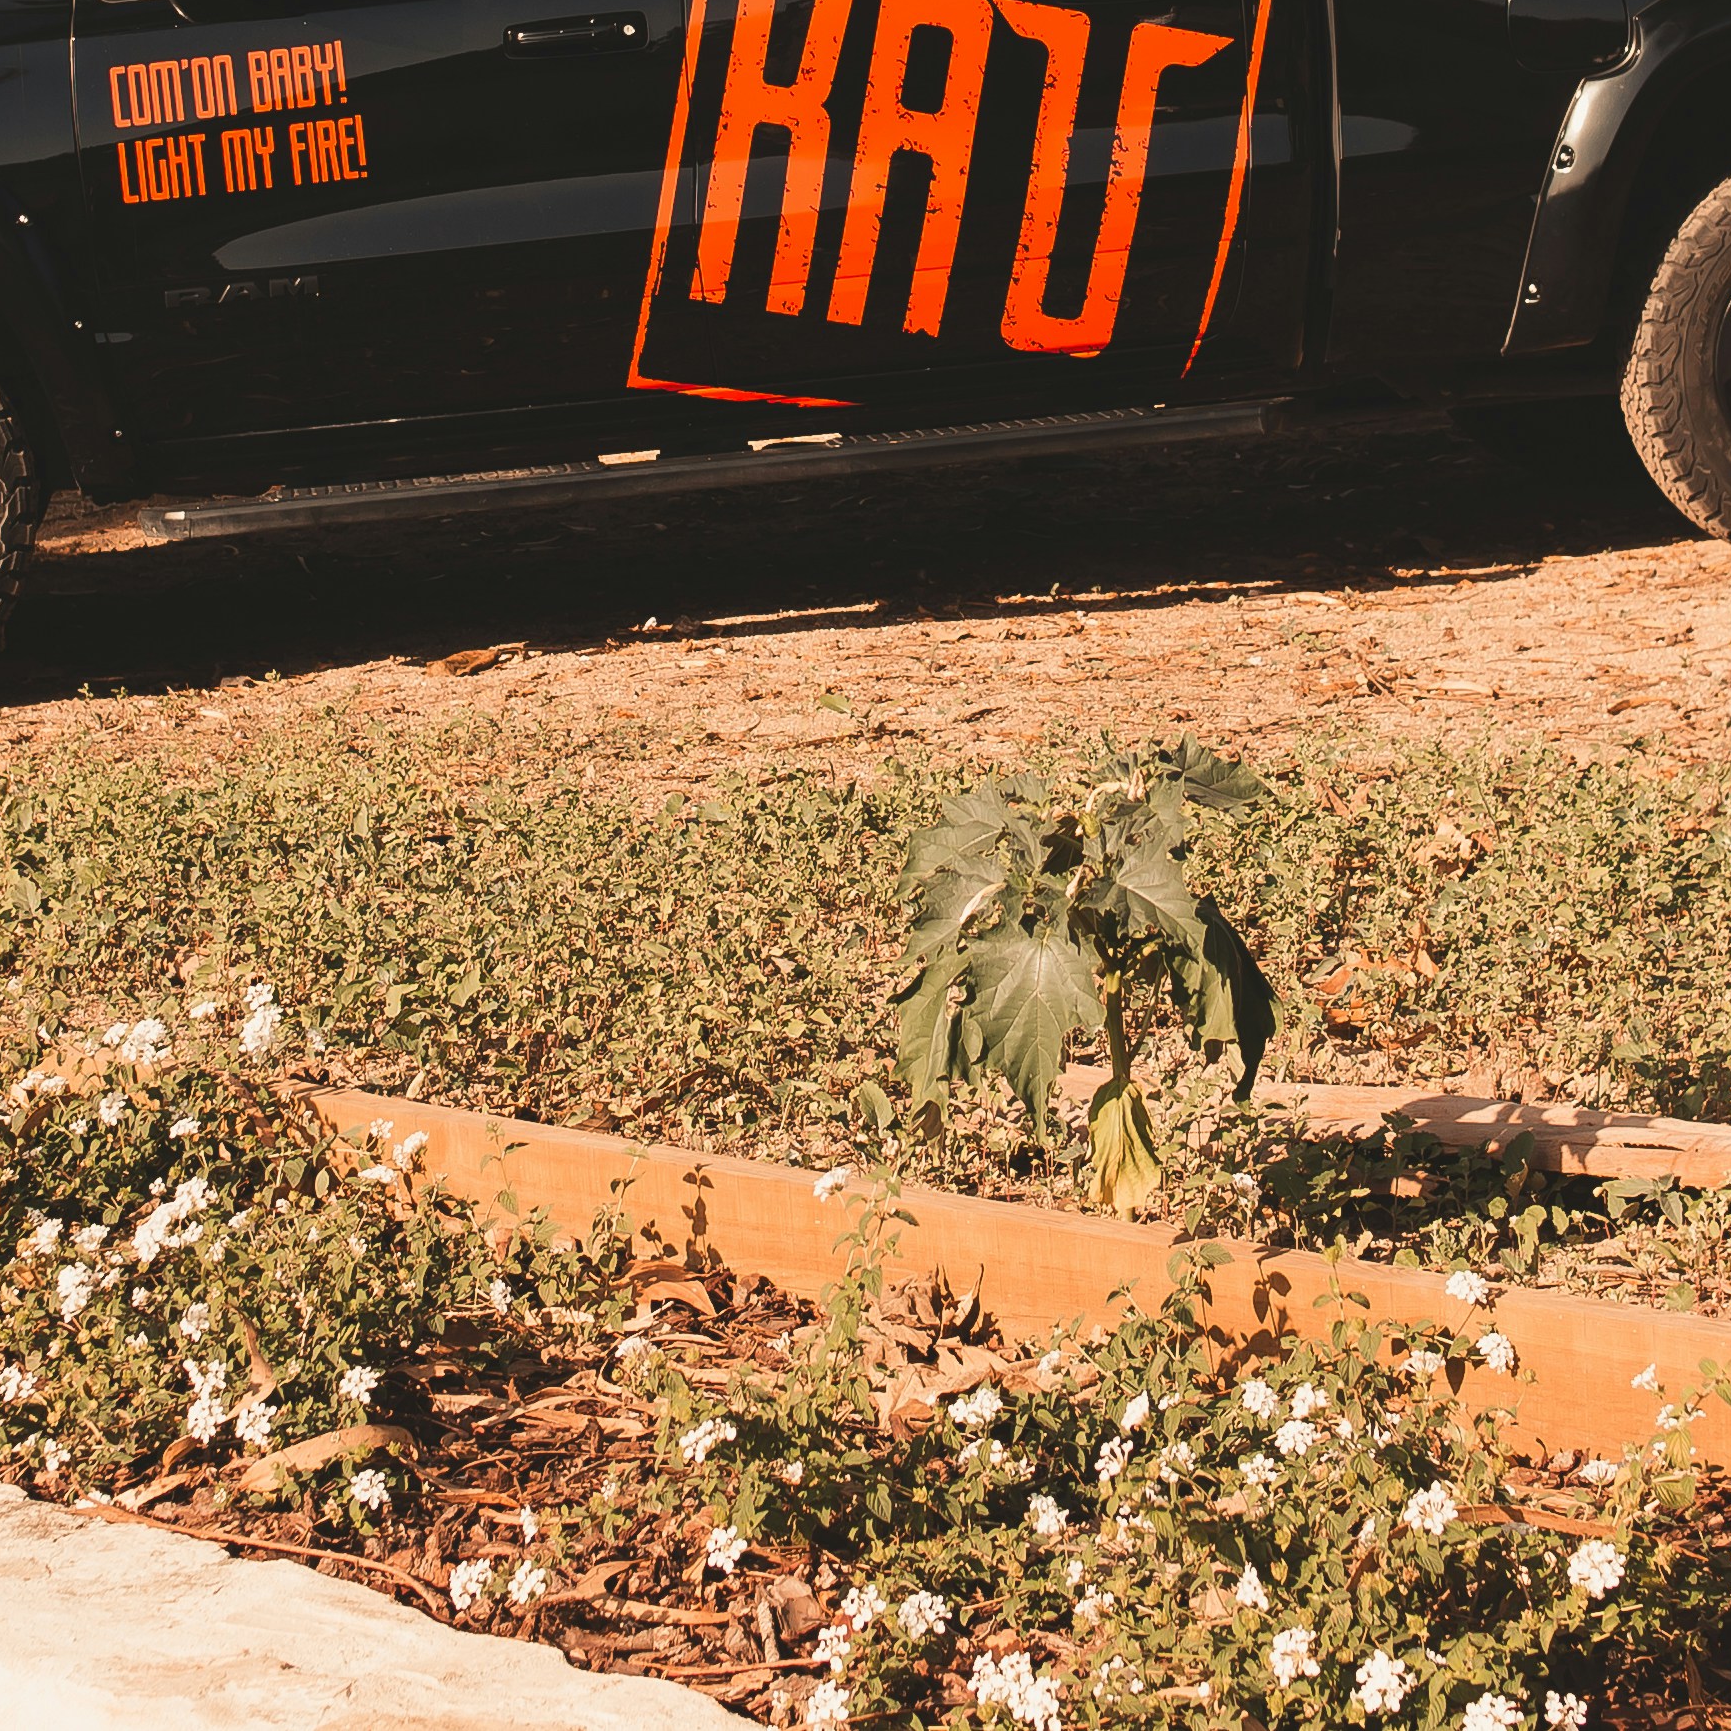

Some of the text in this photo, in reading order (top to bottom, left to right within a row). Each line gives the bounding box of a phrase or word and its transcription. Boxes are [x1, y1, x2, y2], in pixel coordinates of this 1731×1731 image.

[247, 39, 348, 114] BABY!
[116, 114, 368, 204] LIGHT MY FIRE!
[164, 274, 319, 309] RAM
